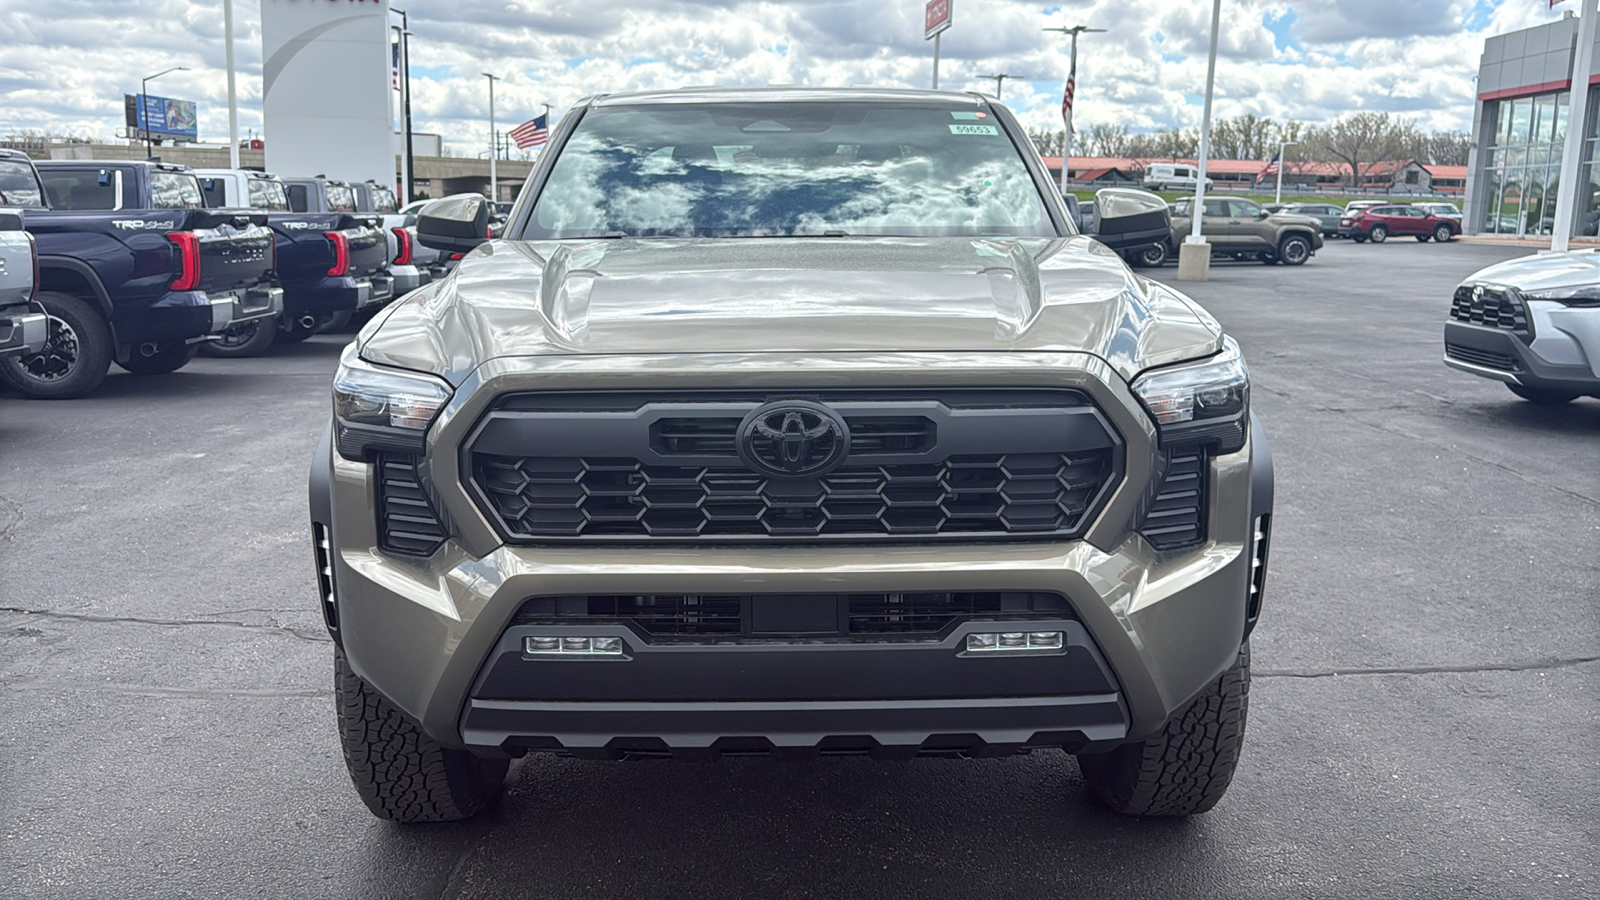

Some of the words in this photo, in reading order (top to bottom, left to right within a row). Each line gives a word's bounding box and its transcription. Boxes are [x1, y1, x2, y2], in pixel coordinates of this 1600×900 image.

[956, 125, 991, 134] 59653
[112, 220, 144, 230] TRD
[282, 221, 308, 230] TRD
